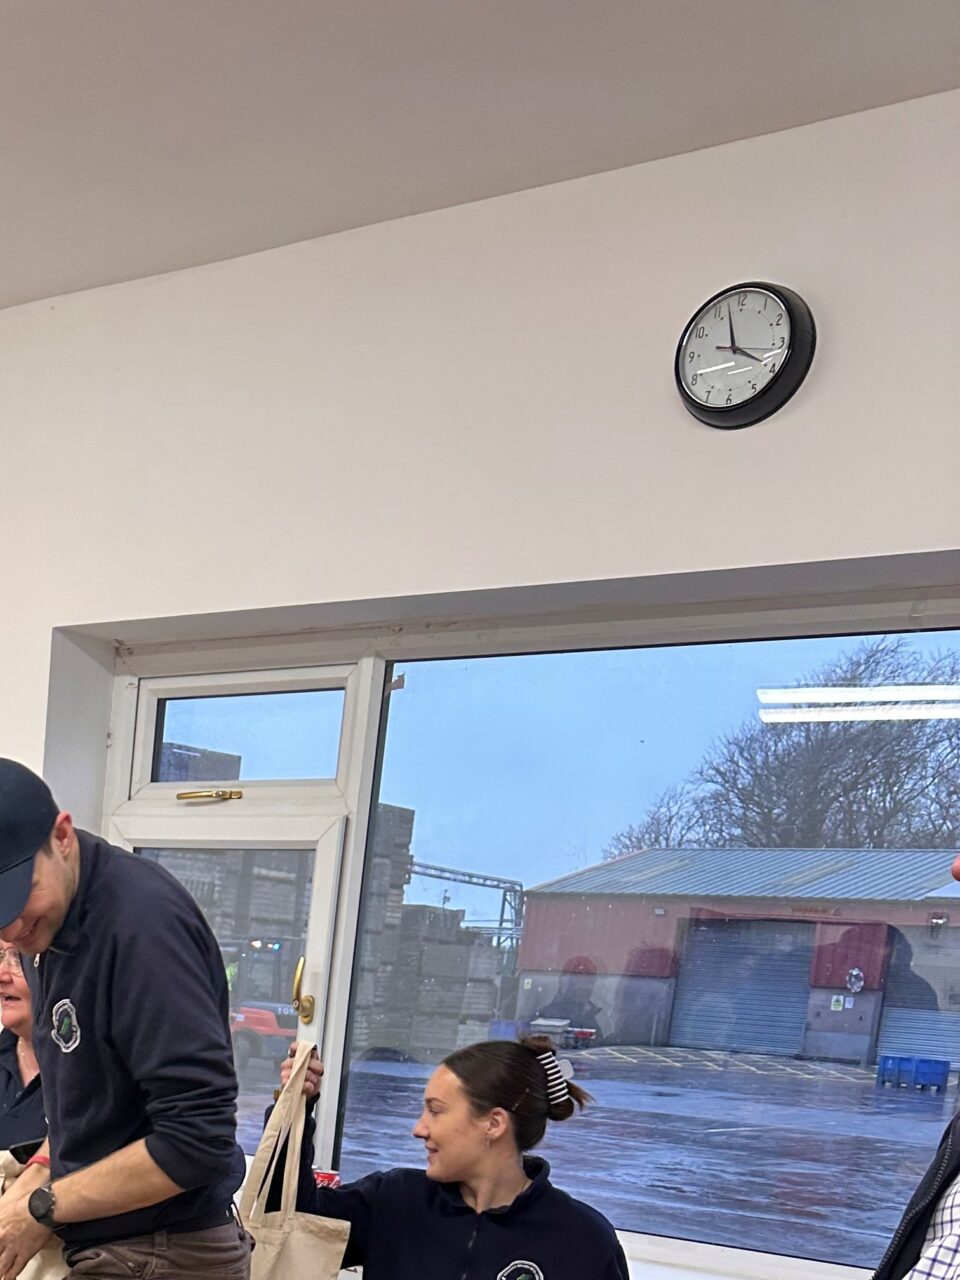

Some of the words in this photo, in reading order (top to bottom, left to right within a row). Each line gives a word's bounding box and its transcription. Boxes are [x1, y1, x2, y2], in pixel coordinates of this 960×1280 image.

[737, 293, 748, 307] 12
[763, 297, 768, 310] 1
[713, 306, 721, 319] 11
[775, 313, 783, 326] 2
[695, 326, 705, 339] 10
[779, 336, 785, 349] 3
[688, 351, 695, 363] 9
[768, 363, 776, 375] 4
[691, 374, 698, 386] 8
[751, 383, 757, 395] 5
[705, 390, 712, 404] 7
[725, 394, 732, 405] 6
